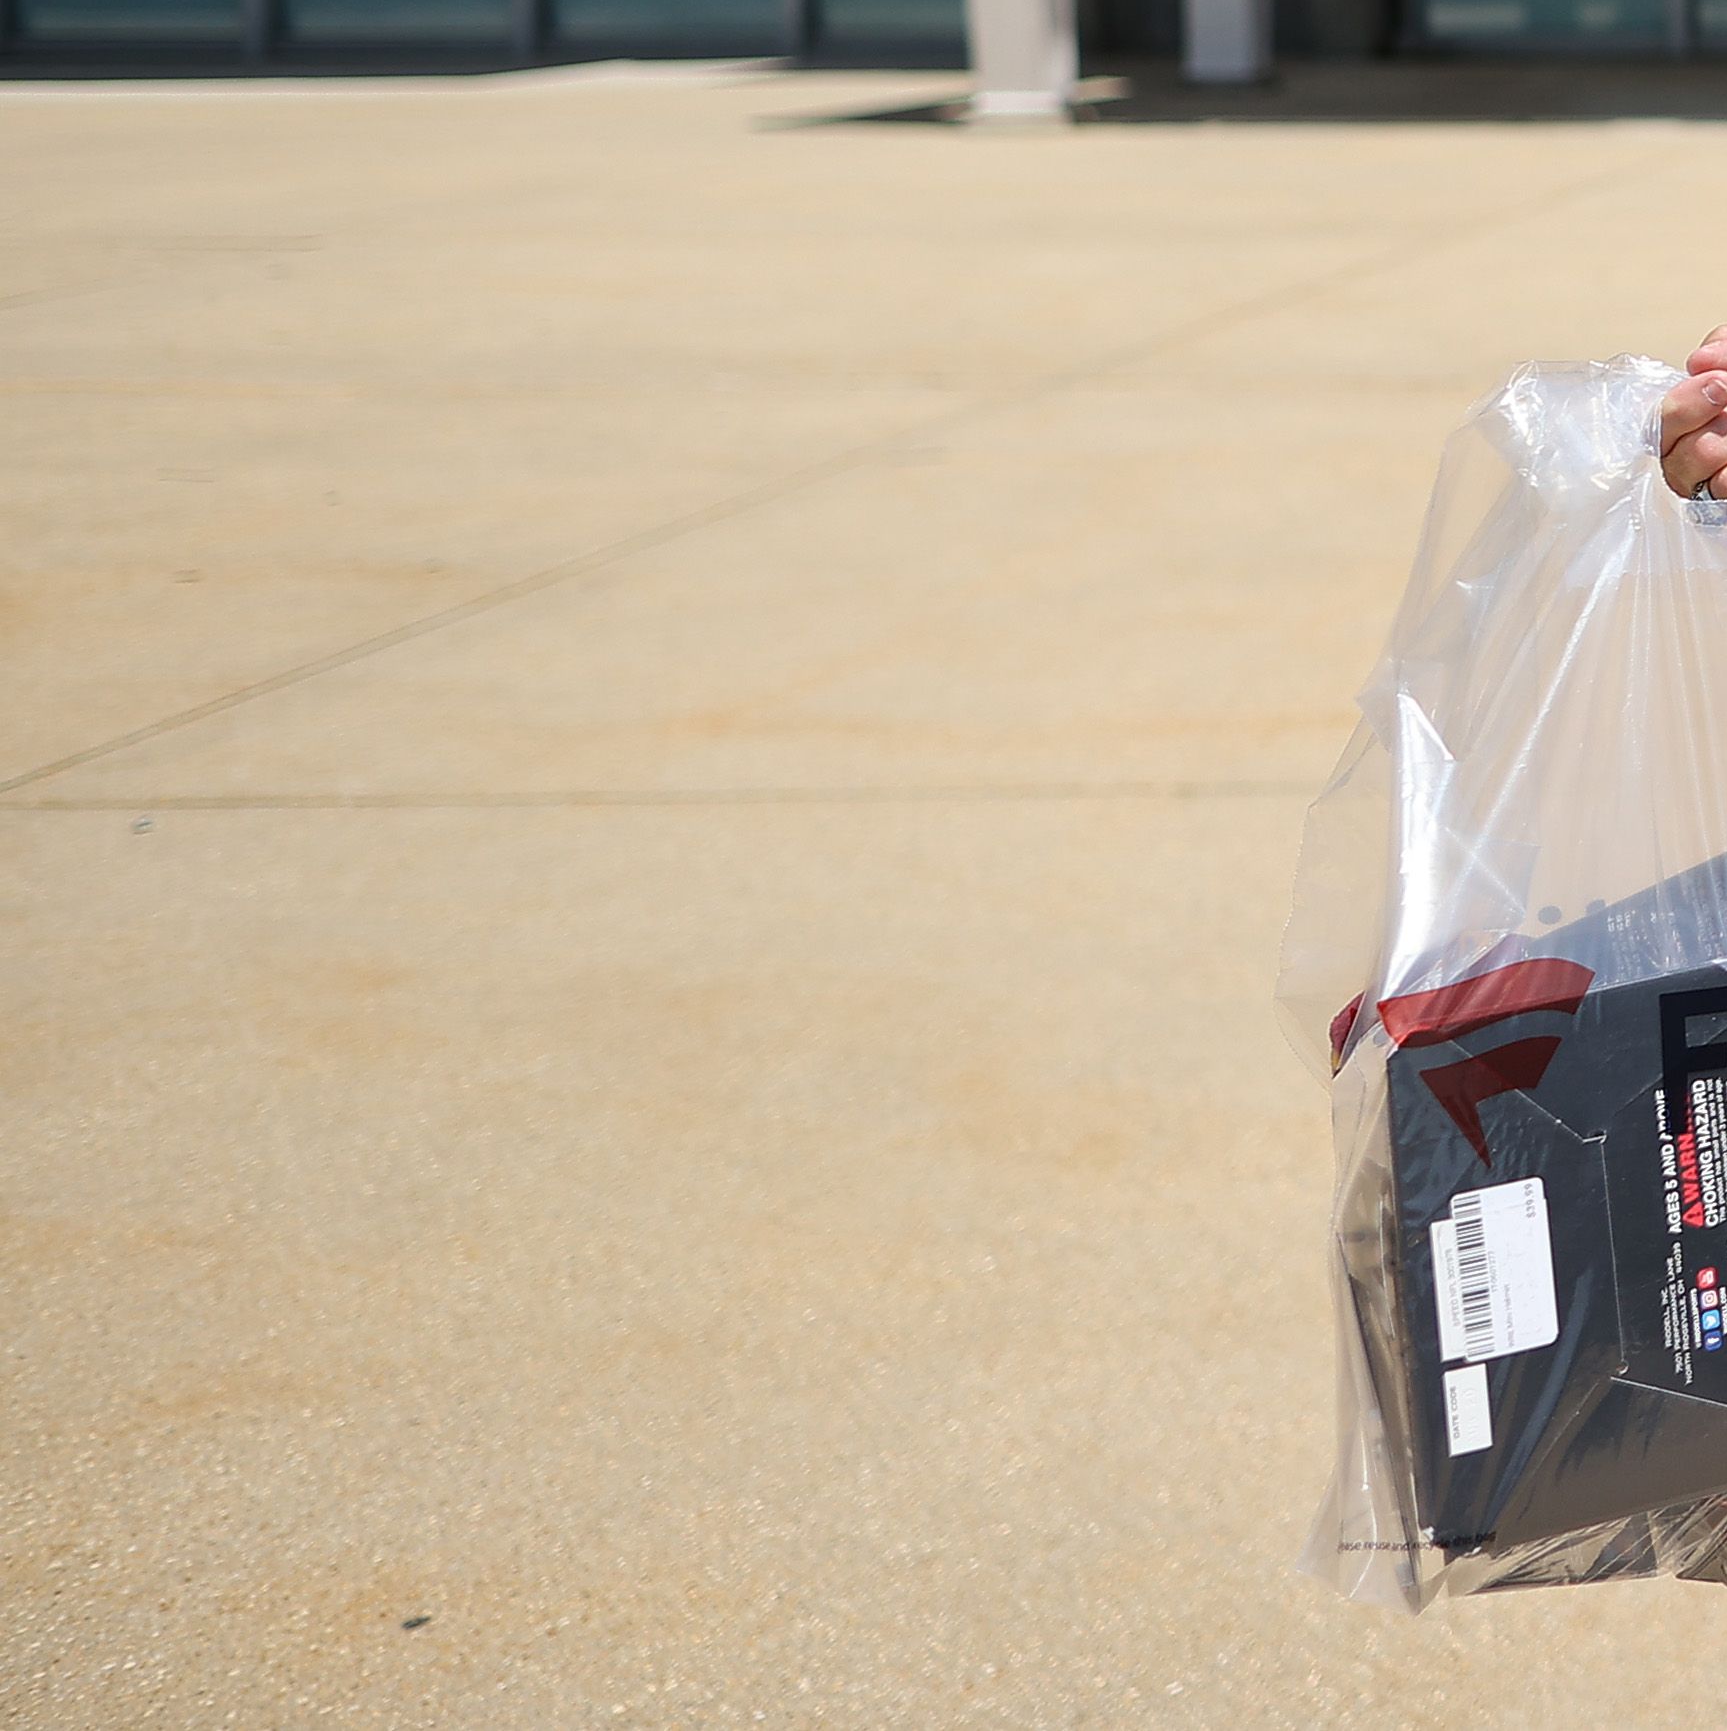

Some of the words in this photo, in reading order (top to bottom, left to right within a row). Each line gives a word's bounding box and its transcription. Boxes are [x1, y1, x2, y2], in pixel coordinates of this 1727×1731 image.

[1692, 1080, 1711, 1147] HAZARD
[1661, 1144, 1677, 1175] AND
[1678, 1093, 1699, 1203] WARN
[1524, 1183, 1536, 1218] $39.99
[1665, 1180, 1678, 1188] 5
[1699, 1151, 1718, 1227] CHOKING
[1666, 1192, 1682, 1233] AGES
